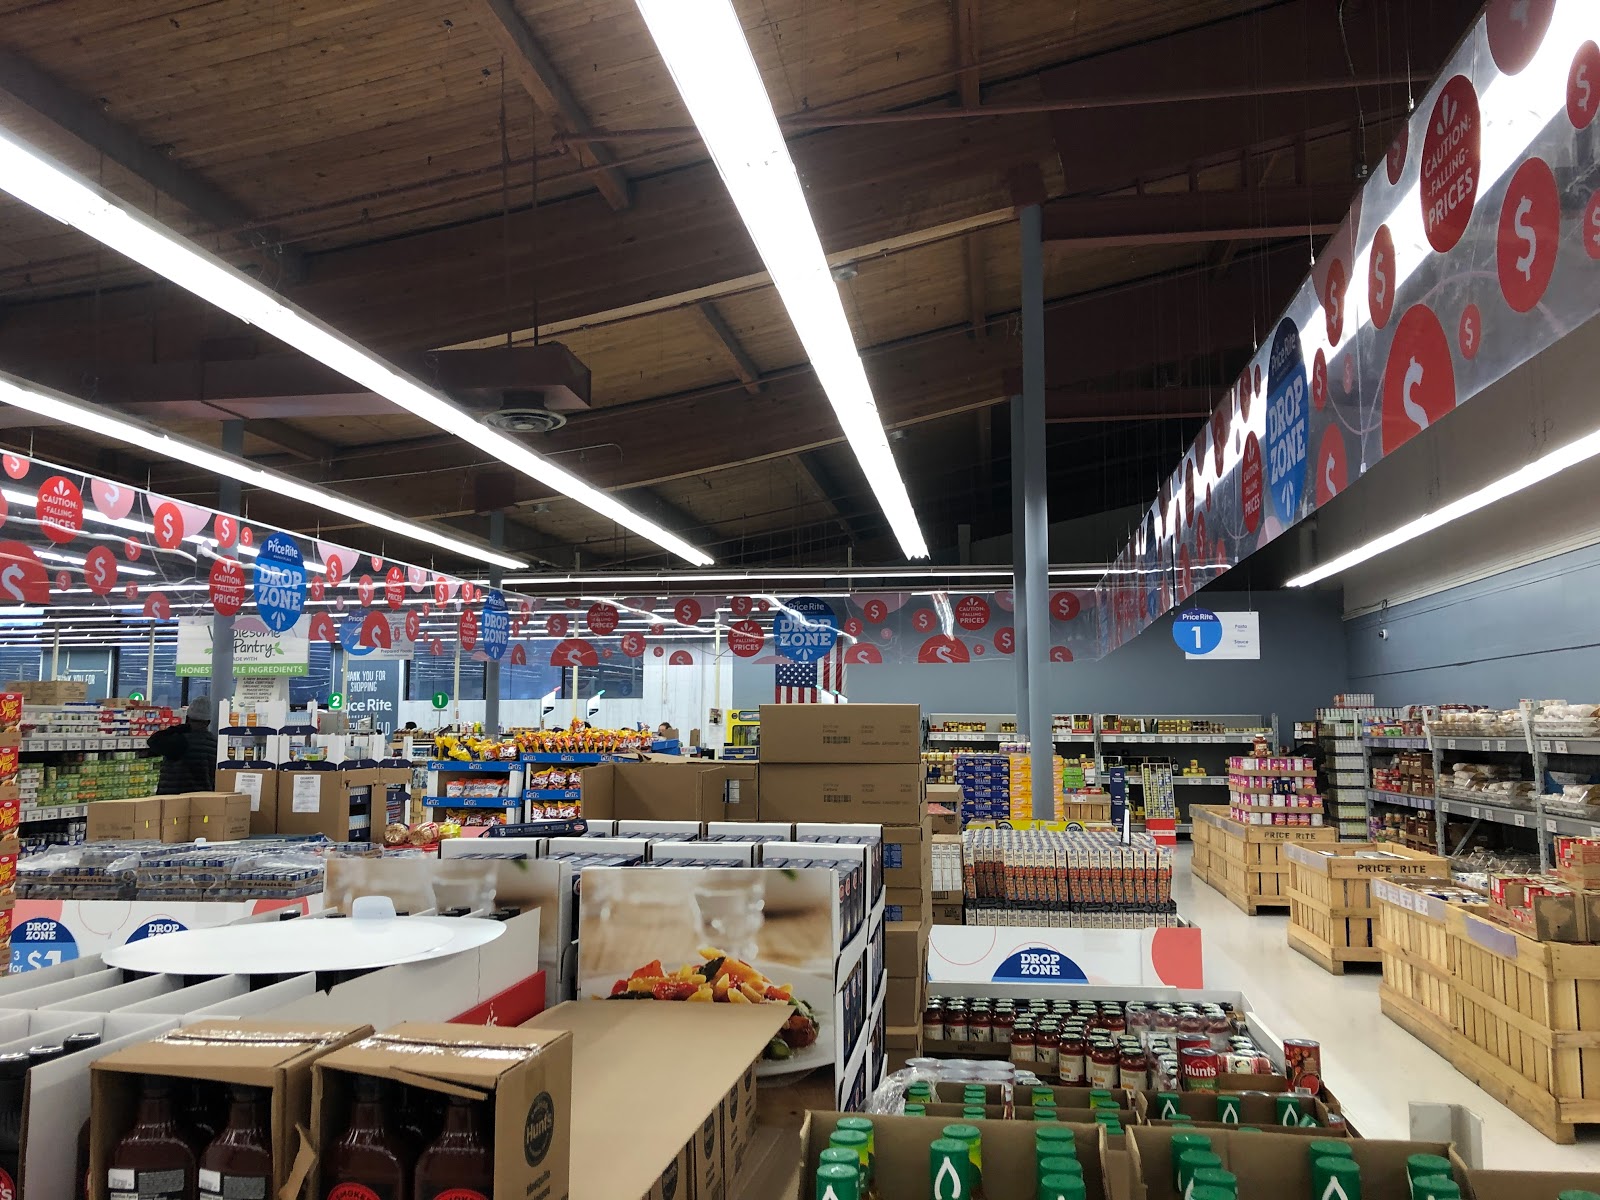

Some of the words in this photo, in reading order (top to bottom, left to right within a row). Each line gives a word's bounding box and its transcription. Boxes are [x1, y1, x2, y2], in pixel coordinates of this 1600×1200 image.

[1428, 167, 1473, 232] PRICES
[1268, 375, 1303, 445] DROP
[1270, 418, 1306, 485] ZONE
[42, 516, 76, 530] PRICES
[260, 563, 302, 590] DROP
[213, 593, 240, 606] PRICES
[258, 586, 301, 612] ZONE
[484, 613, 508, 630] DROP
[780, 619, 832, 633] DROP
[484, 629, 507, 645] ZONE
[780, 633, 832, 646] ZONE
[1191, 625, 1201, 649] 1
[234, 639, 274, 658] Pantry
[346, 671, 361, 681] HANK
[362, 671, 374, 681] YOU
[375, 670, 386, 681] FOR
[350, 681, 377, 692] SHOPPING
[331, 695, 340, 706] 2
[367, 698, 392, 711] Rite
[437, 694, 443, 706] 1
[1264, 831, 1290, 839] PRICE
[1295, 832, 1316, 840] RITE
[1357, 864, 1392, 873] PRICE
[1400, 865, 1426, 874] RITE
[25, 922, 57, 931] DROP
[147, 923, 180, 933] DROP
[25, 931, 56, 940] ZONE
[13, 950, 20, 961] 3
[1020, 953, 1060, 965] DROP
[9, 962, 24, 973] for
[1020, 964, 1060, 976] ZONE
